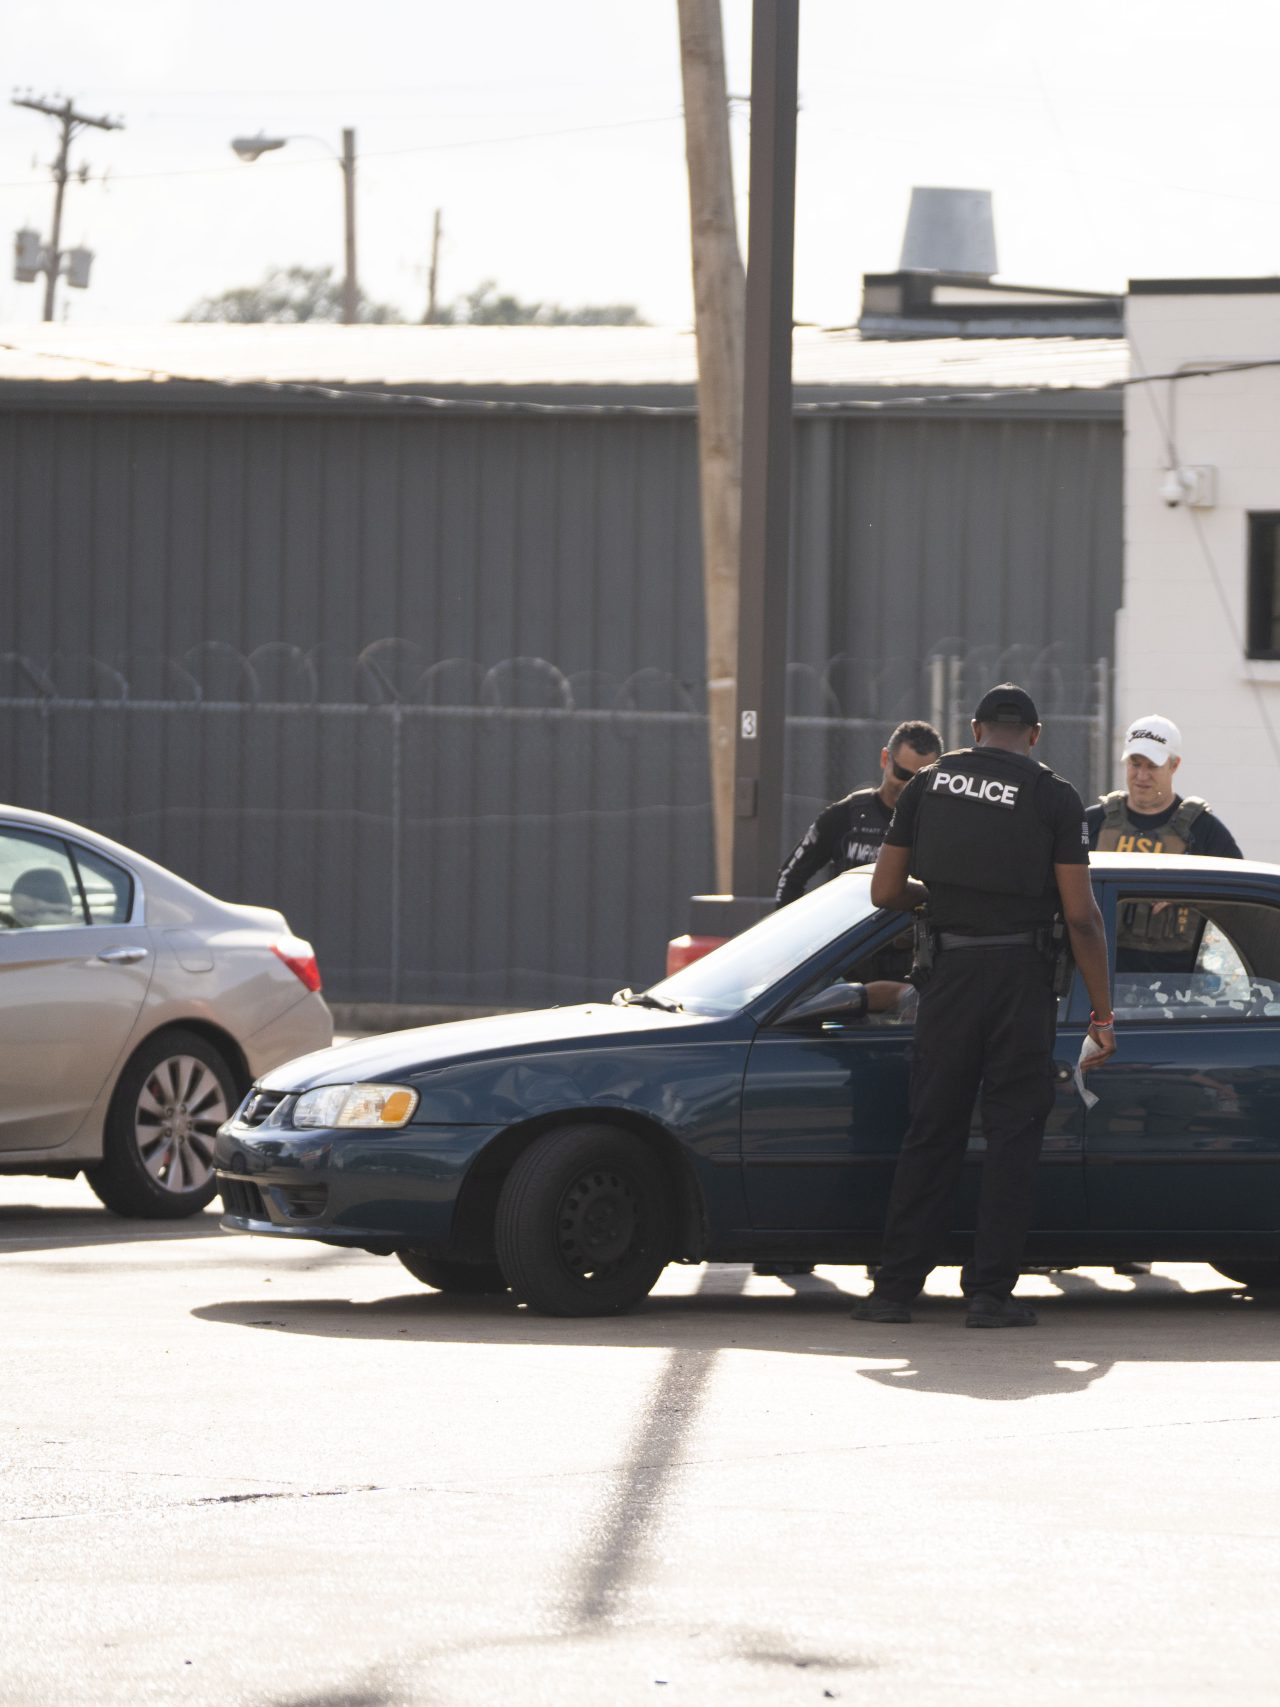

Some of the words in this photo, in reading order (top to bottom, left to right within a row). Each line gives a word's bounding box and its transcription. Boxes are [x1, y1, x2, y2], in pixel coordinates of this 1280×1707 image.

[744, 712, 754, 736] 3
[932, 771, 1019, 805] POLICE
[1116, 835, 1163, 853] HSI
